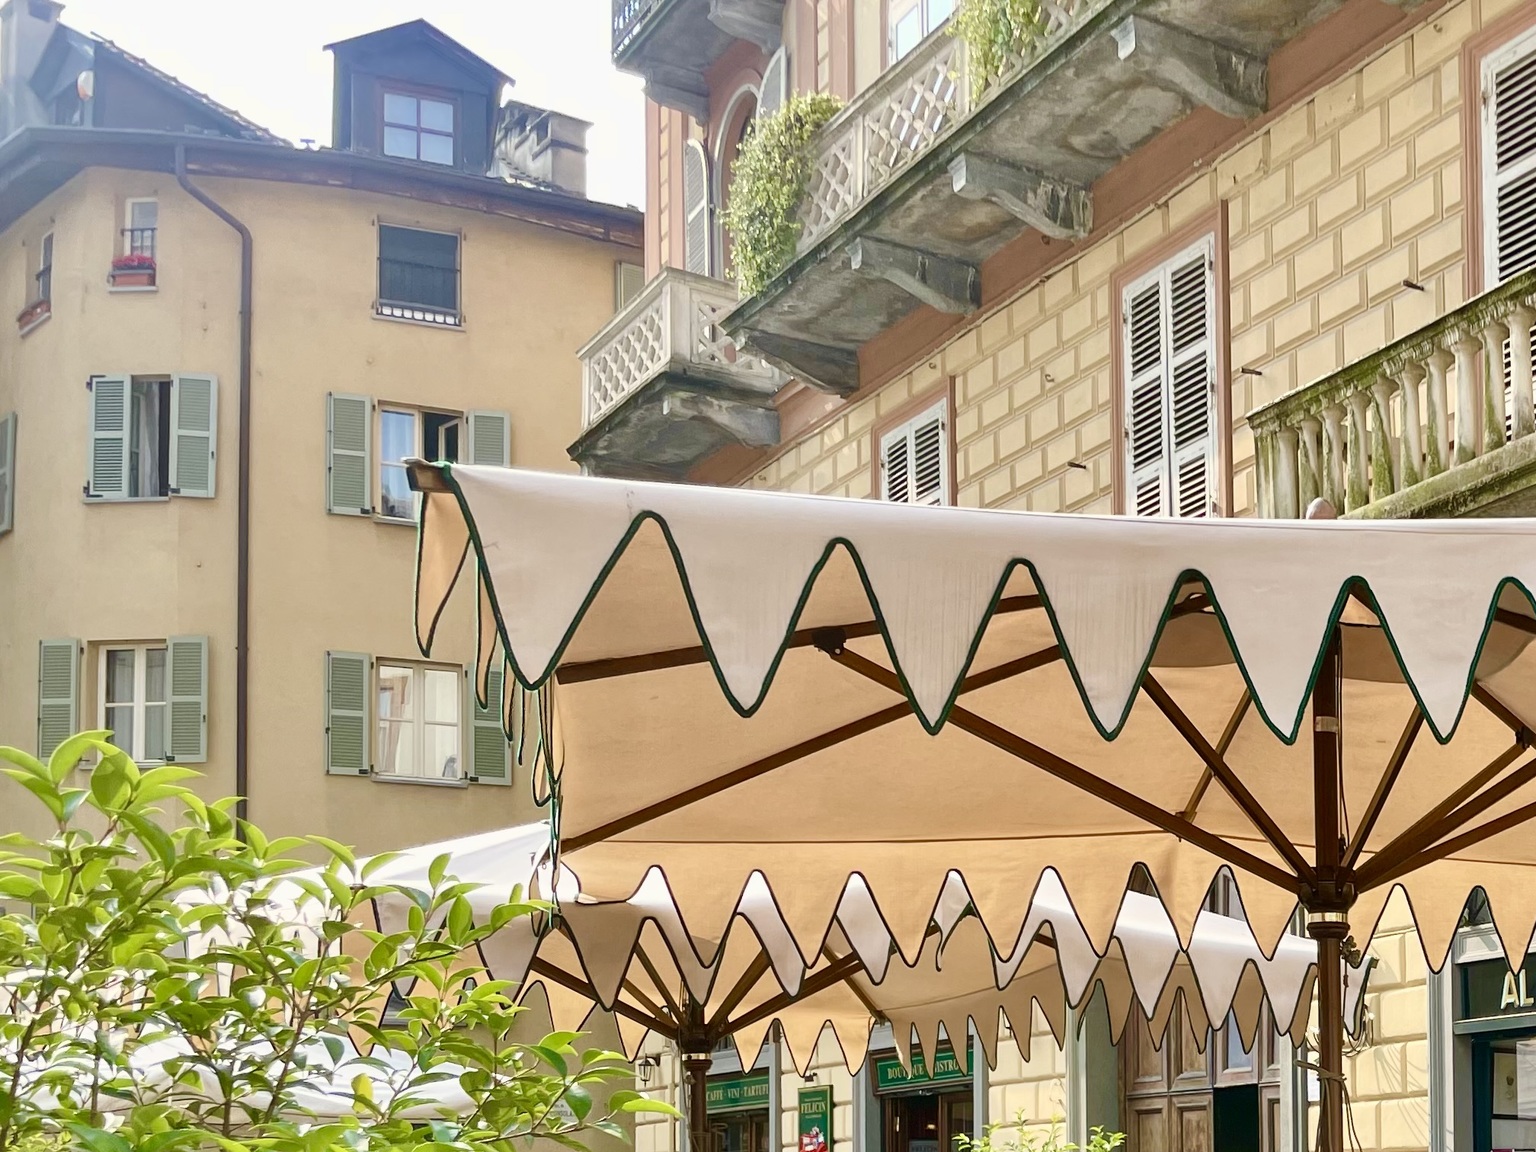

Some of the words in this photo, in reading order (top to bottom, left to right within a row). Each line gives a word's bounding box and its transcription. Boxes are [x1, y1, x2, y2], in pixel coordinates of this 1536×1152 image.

[1500, 967, 1534, 1010] AL
[727, 1087, 741, 1099] VINI
[801, 1101, 826, 1114] FELICIN
